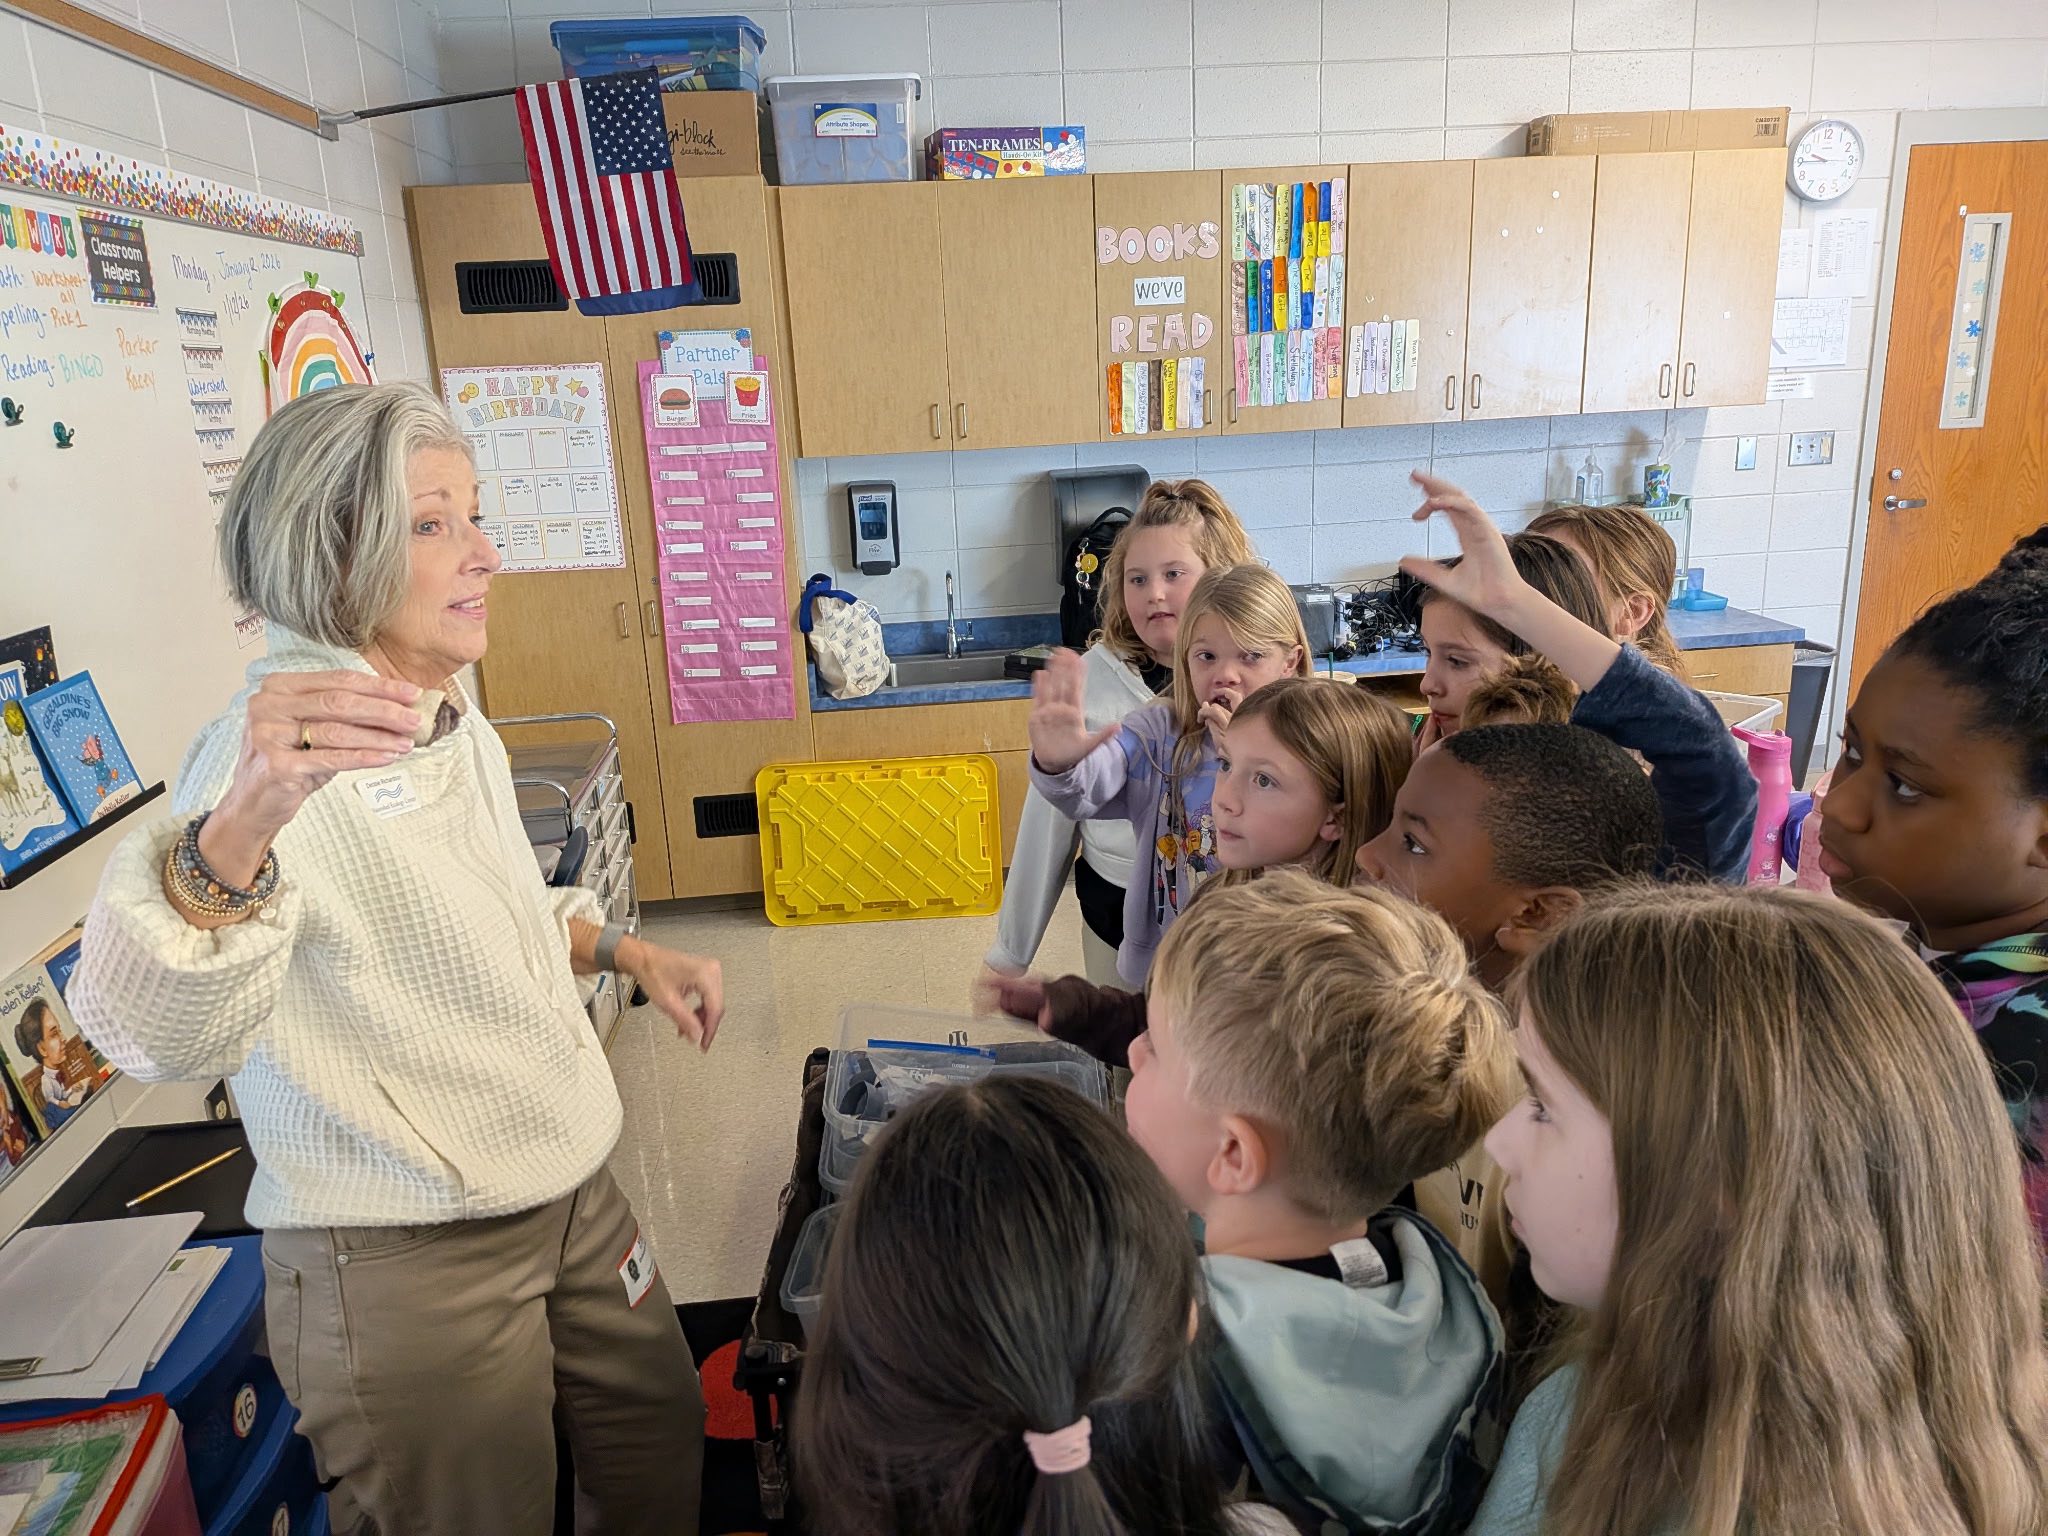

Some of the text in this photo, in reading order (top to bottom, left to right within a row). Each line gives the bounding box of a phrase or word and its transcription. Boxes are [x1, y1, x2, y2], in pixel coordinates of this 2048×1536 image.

[1824, 128, 1834, 140] 12
[1840, 132, 1843, 142] 1
[948, 138, 1041, 152] TEN-FRAMES
[1801, 144, 1812, 154] 10
[1845, 142, 1852, 152] 2
[1797, 156, 1804, 168] 9
[1848, 155, 1854, 166] 3
[1798, 170, 1806, 180] 8
[1841, 168, 1848, 178] 4
[1808, 180, 1814, 190] 7
[1818, 182, 1826, 194] 6
[91, 236, 144, 262] Classroom
[1098, 221, 1220, 265] BOOKS
[102, 261, 140, 284] Helpers
[1110, 312, 1214, 353] READ
[116, 328, 159, 358] Parker
[675, 346, 740, 362] Partner
[59, 354, 104, 384] BINGO
[1290, 347, 1300, 387] Stellaluna
[485, 375, 560, 396] HAPPY
[466, 397, 586, 428] BIRTHDAY!
[43, 693, 91, 730] GERALDINE'S
[52, 708, 90, 738] BIG SNOW
[104, 802, 117, 815] Holly
